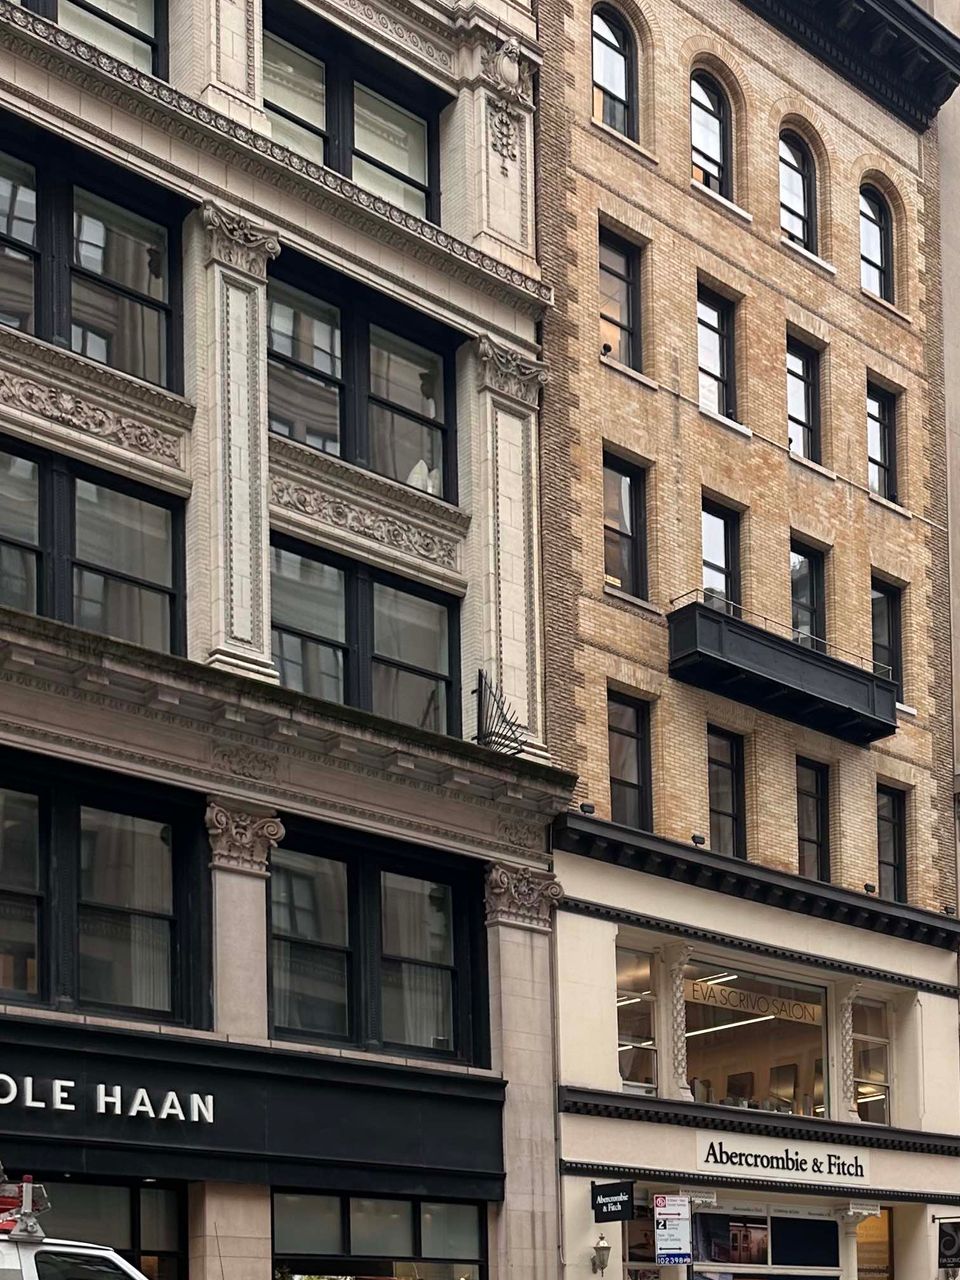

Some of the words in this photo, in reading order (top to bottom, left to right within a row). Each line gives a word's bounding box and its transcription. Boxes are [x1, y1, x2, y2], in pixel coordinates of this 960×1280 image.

[692, 983, 717, 1004] EVA
[719, 989, 769, 1014] SCRIVO
[770, 999, 815, 1022] SALON
[96, 1083, 214, 1123] HAAN
[704, 1141, 808, 1172] Abercrombie
[811, 1157, 824, 1174] &
[827, 1153, 865, 1178] Fitch
[596, 1192, 629, 1204] Abercrombie
[608, 1202, 622, 1212] Fitch
